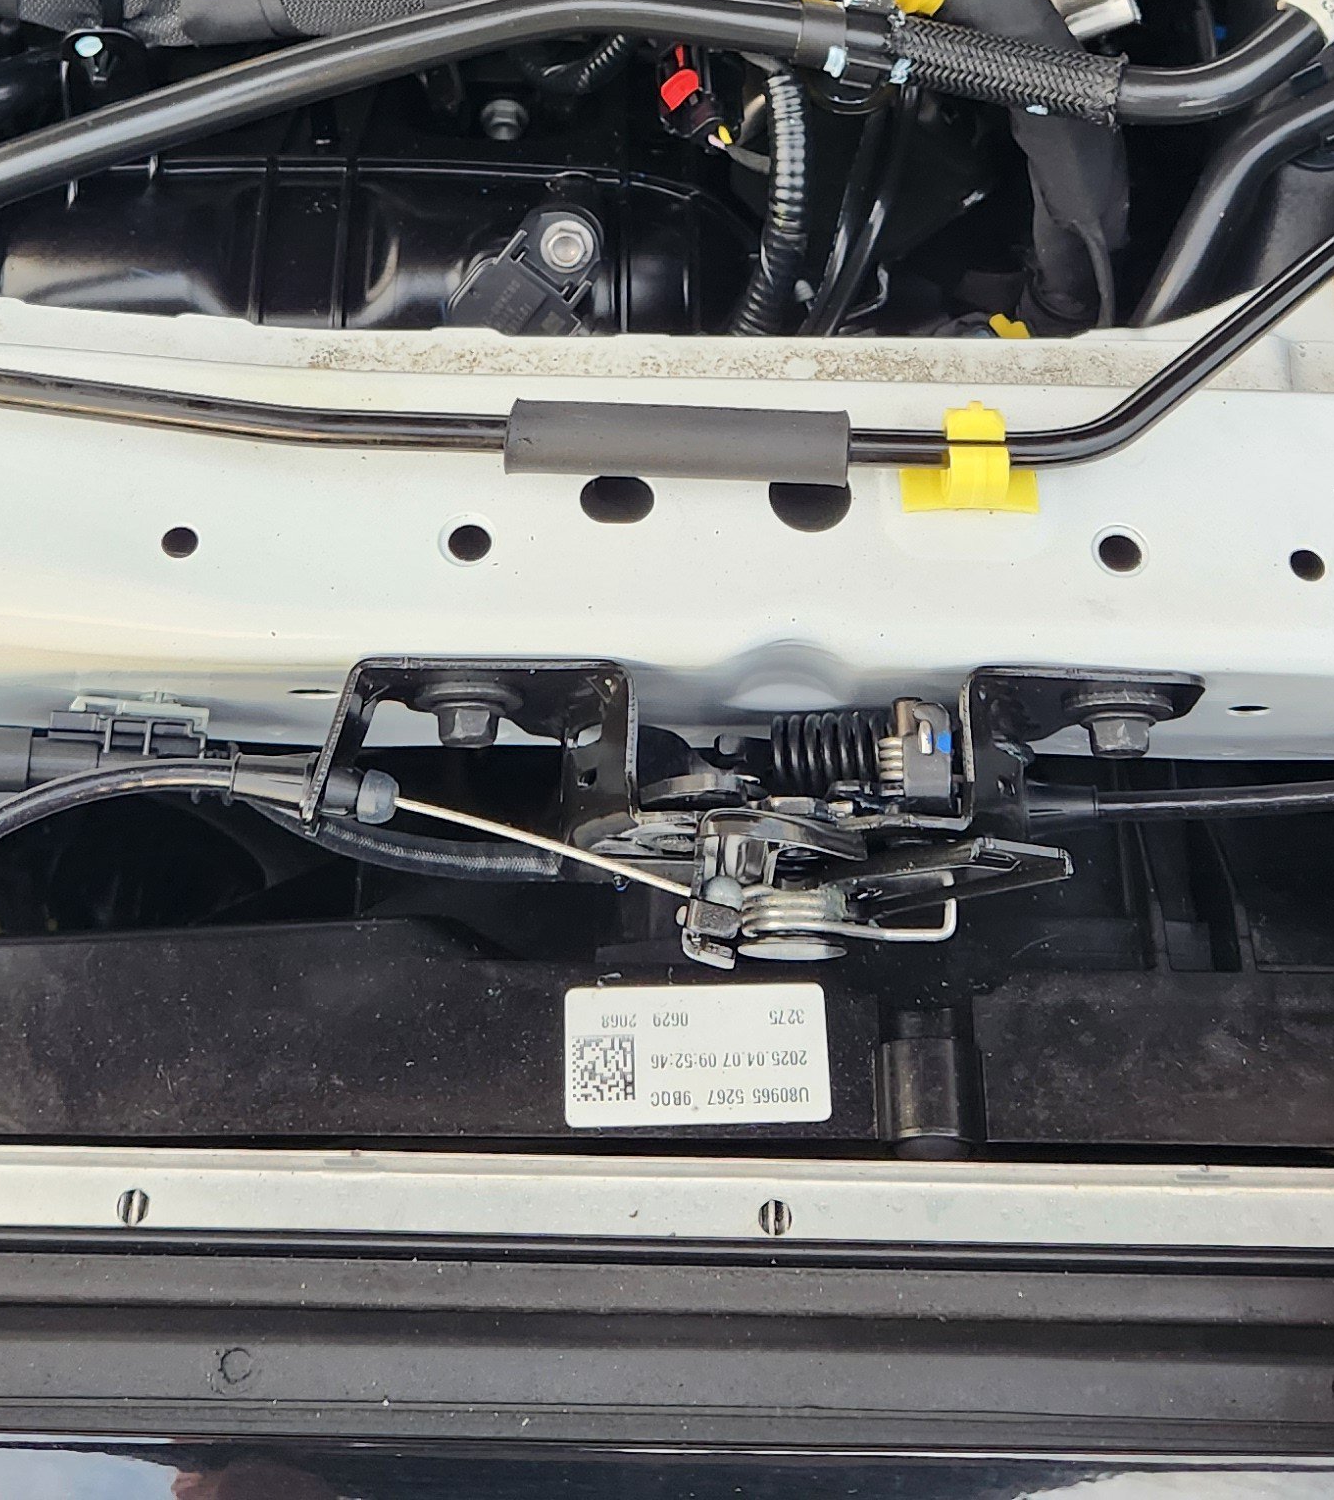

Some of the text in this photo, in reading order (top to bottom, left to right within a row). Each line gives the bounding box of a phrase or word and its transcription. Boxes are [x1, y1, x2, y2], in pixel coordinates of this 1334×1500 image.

[652, 1010, 689, 1027] 0629
[768, 1008, 805, 1025] 3275
[650, 1049, 808, 1070] 2025.04.07 09:52:46
[707, 1087, 744, 1106] 5267
[752, 1085, 809, 1104] U80965
